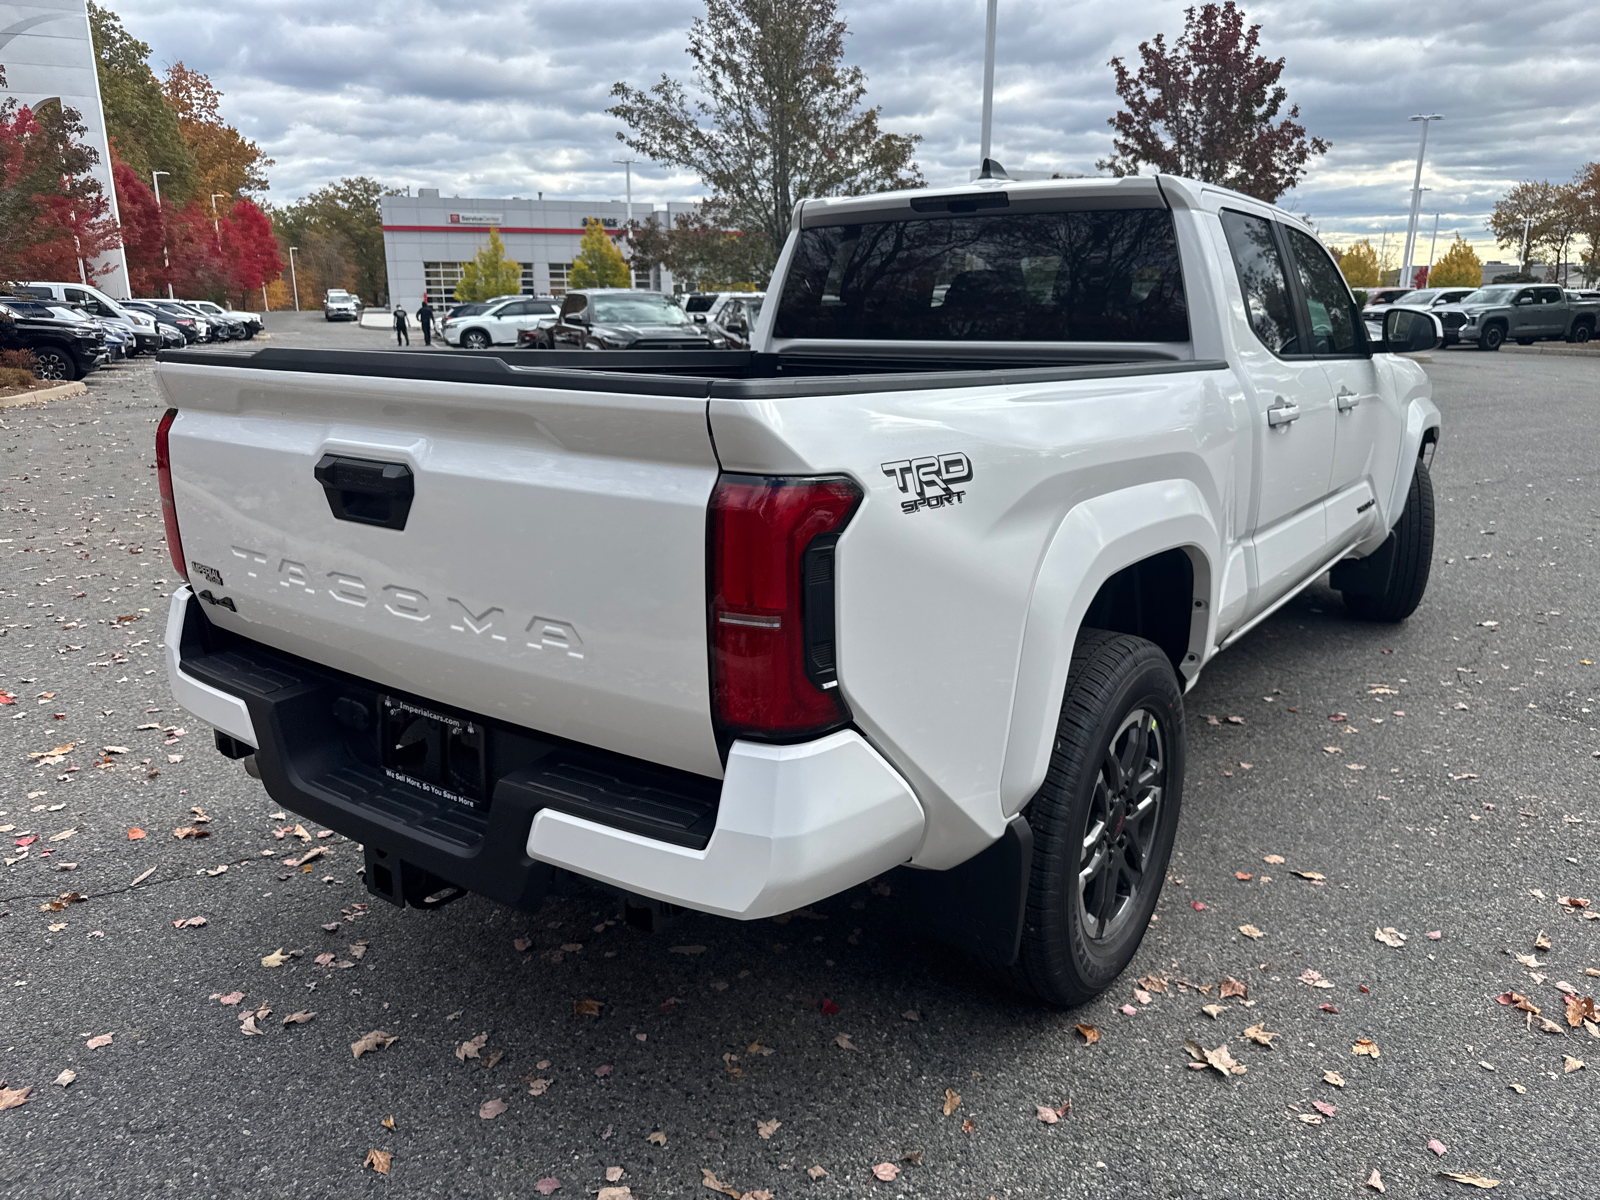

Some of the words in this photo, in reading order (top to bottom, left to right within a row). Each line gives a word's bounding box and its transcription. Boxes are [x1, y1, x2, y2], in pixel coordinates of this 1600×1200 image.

[881, 452, 974, 500] TRD
[901, 490, 966, 515] SPORT
[231, 545, 584, 659] TACOMA
[400, 702, 460, 727] Imperialcars.com
[386, 770, 395, 779] We
[395, 773, 406, 783] Sell
[407, 777, 421, 789] More,
[422, 783, 430, 791] So
[431, 786, 442, 796] You
[443, 791, 457, 802] Save
[458, 796, 474, 807] More
